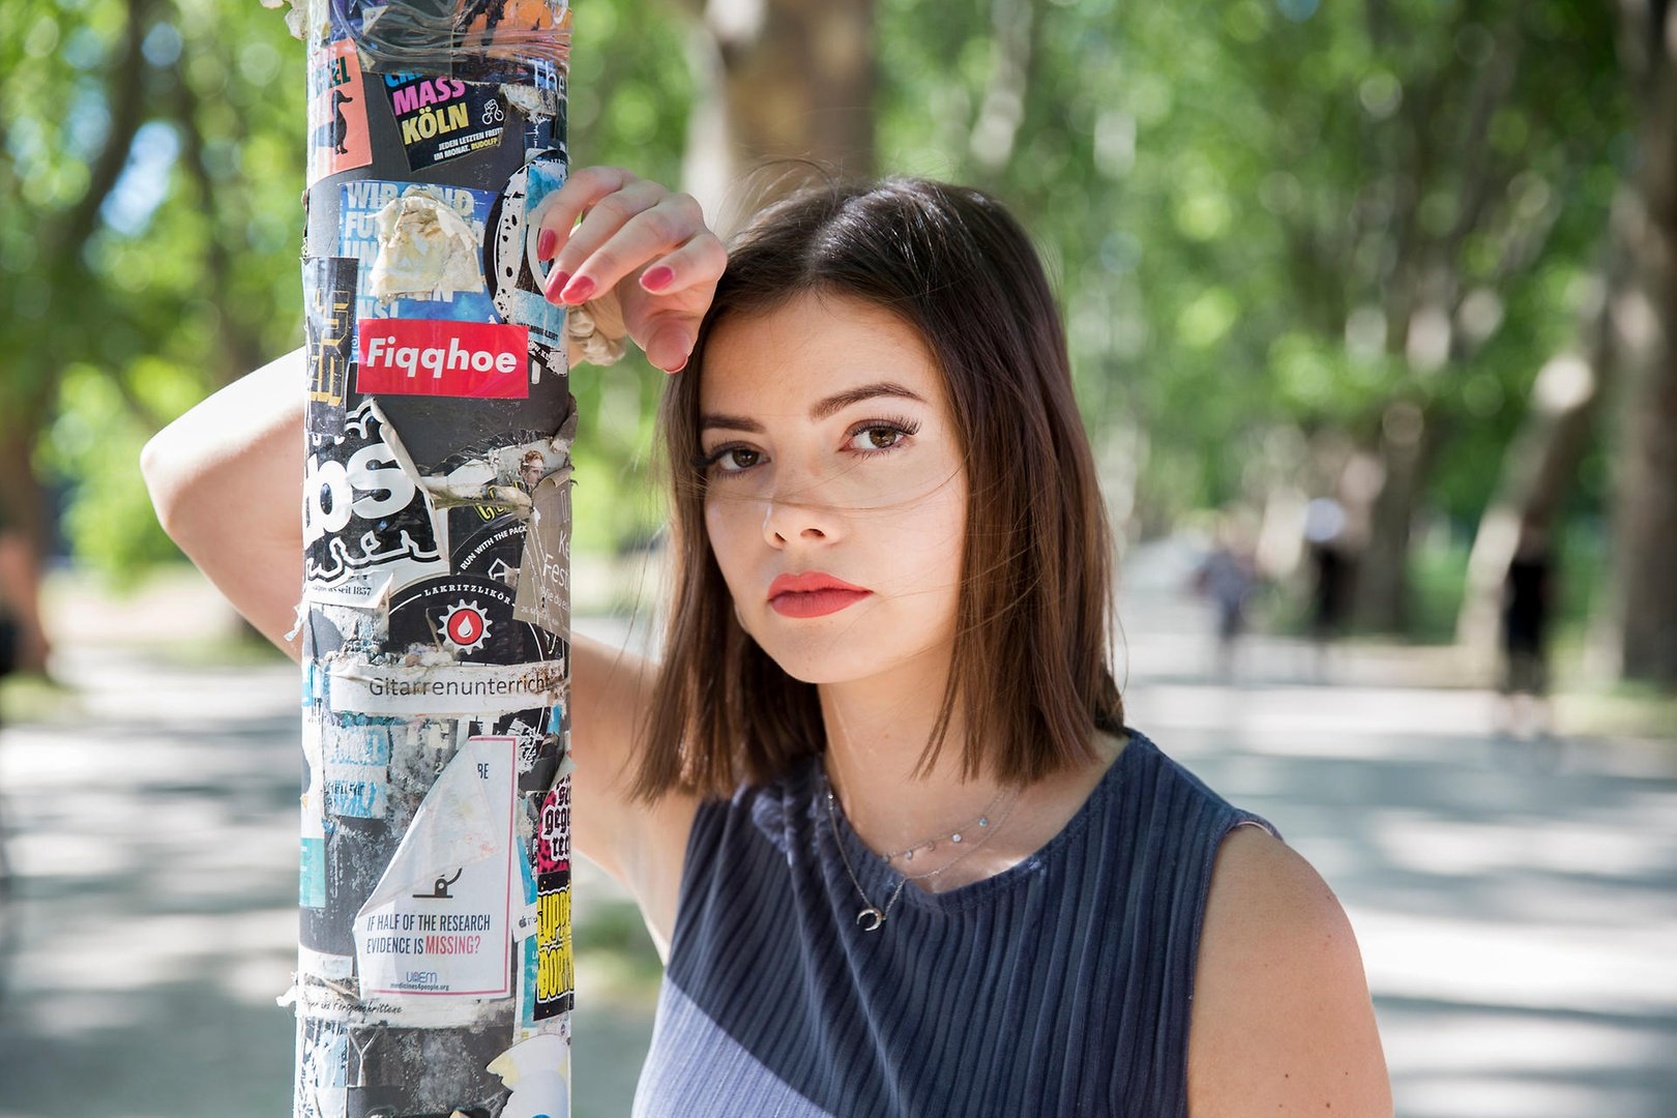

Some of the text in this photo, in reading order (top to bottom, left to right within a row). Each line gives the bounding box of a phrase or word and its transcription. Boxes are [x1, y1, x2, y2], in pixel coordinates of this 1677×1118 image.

[393, 75, 465, 116] MASS
[402, 102, 469, 145] KÖLN
[439, 142, 459, 151] JEDEN
[459, 132, 485, 145] LETZTEN
[433, 152, 444, 161] IM
[366, 336, 517, 378] Fiqqhoe
[460, 525, 528, 571] RUN WITH THE PACK
[424, 584, 511, 605] LAKRITZLIKÖR
[369, 671, 551, 697] Gitarrenunterricht
[367, 914, 491, 932] IF HALF OF THE RESEARCH
[367, 935, 481, 955] EVIDENCE IS MISSING?
